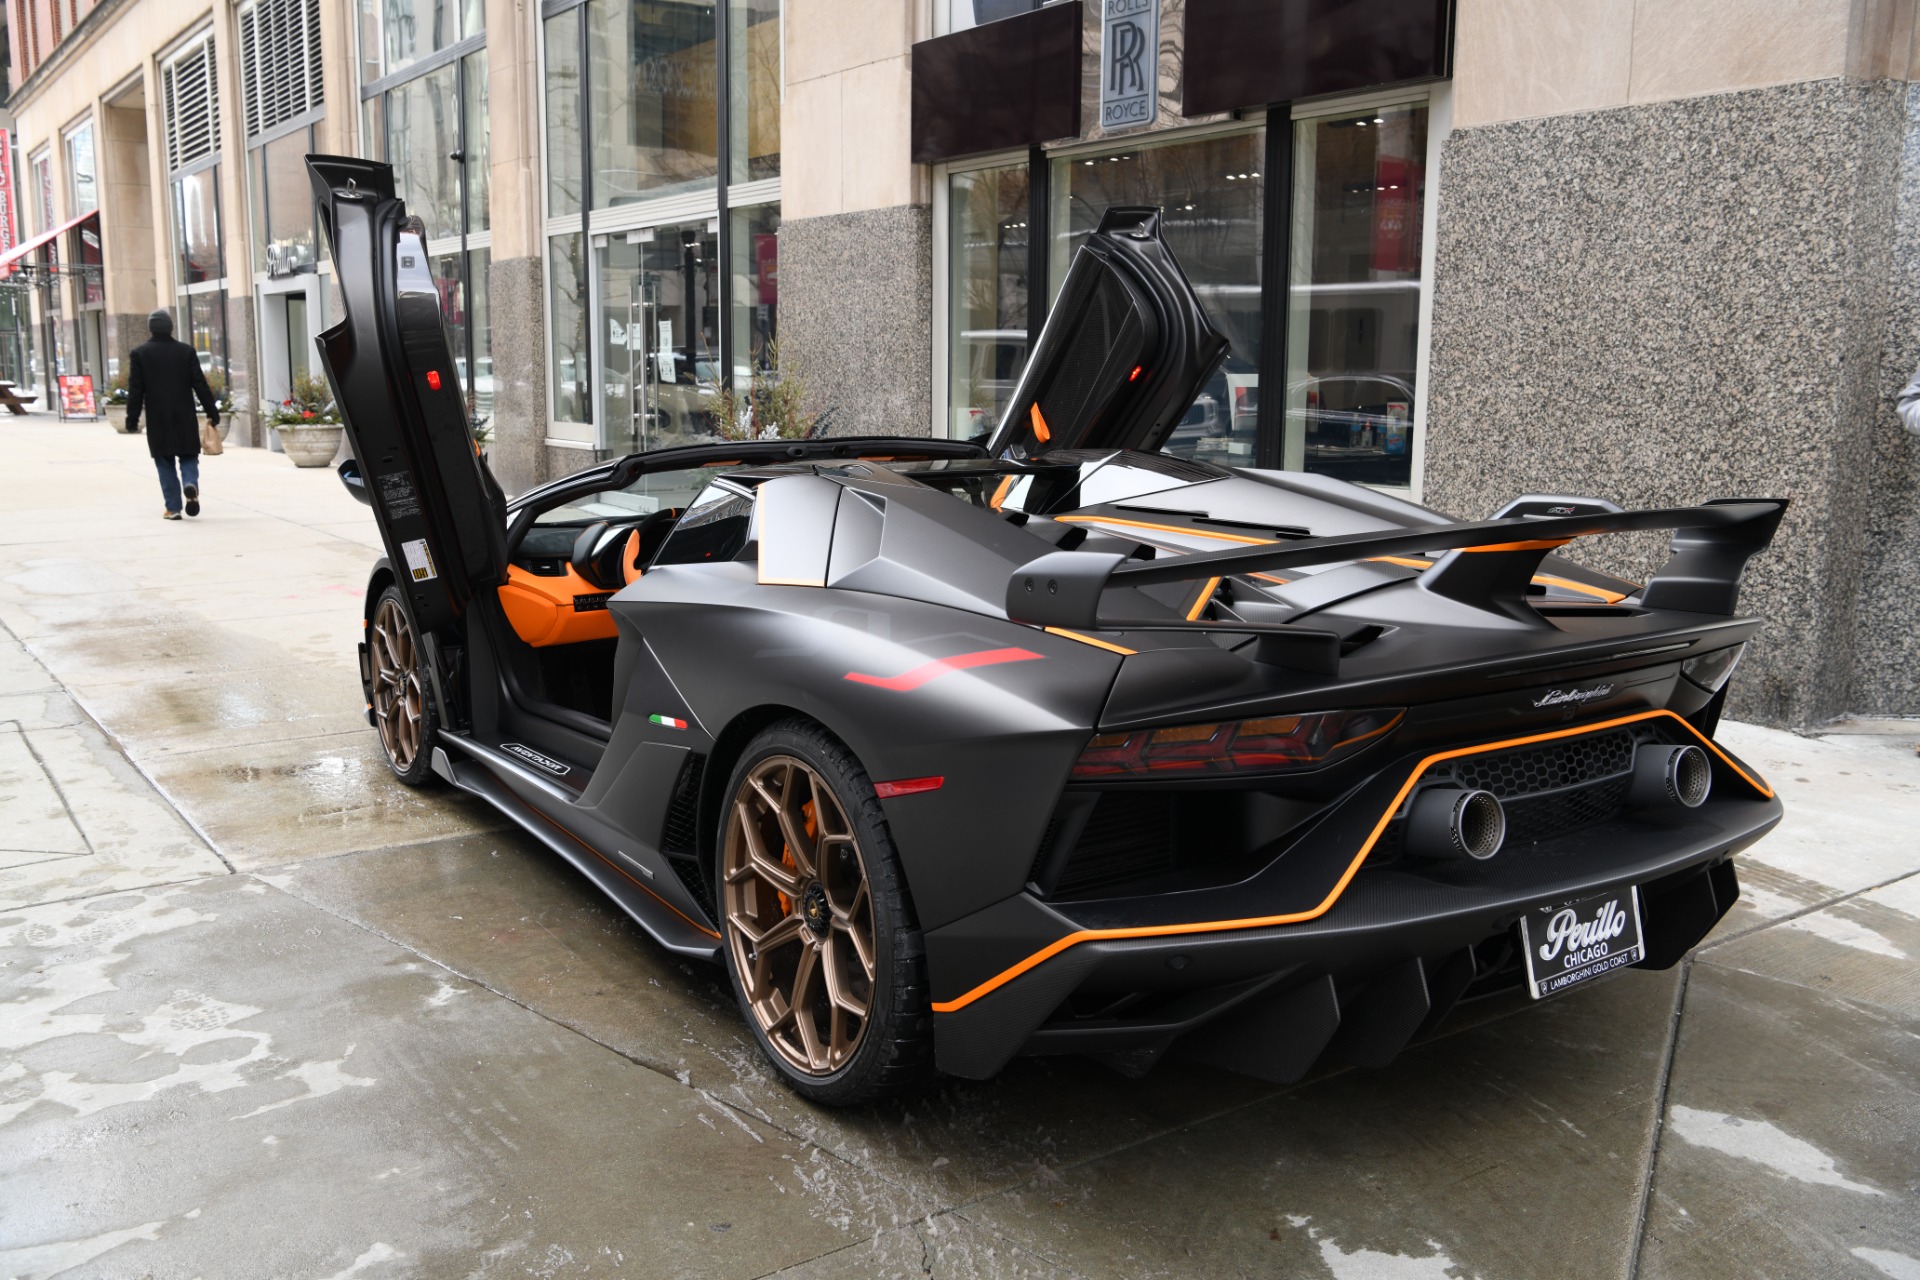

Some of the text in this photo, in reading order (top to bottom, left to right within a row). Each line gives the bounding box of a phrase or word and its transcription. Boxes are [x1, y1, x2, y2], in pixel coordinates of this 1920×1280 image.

[1105, 101, 1146, 120] ROYCE
[1539, 899, 1626, 961] Perillo
[1564, 942, 1608, 968] CHICAGO
[1550, 953, 1628, 990] LAMBORGHINI GOLD COAST
